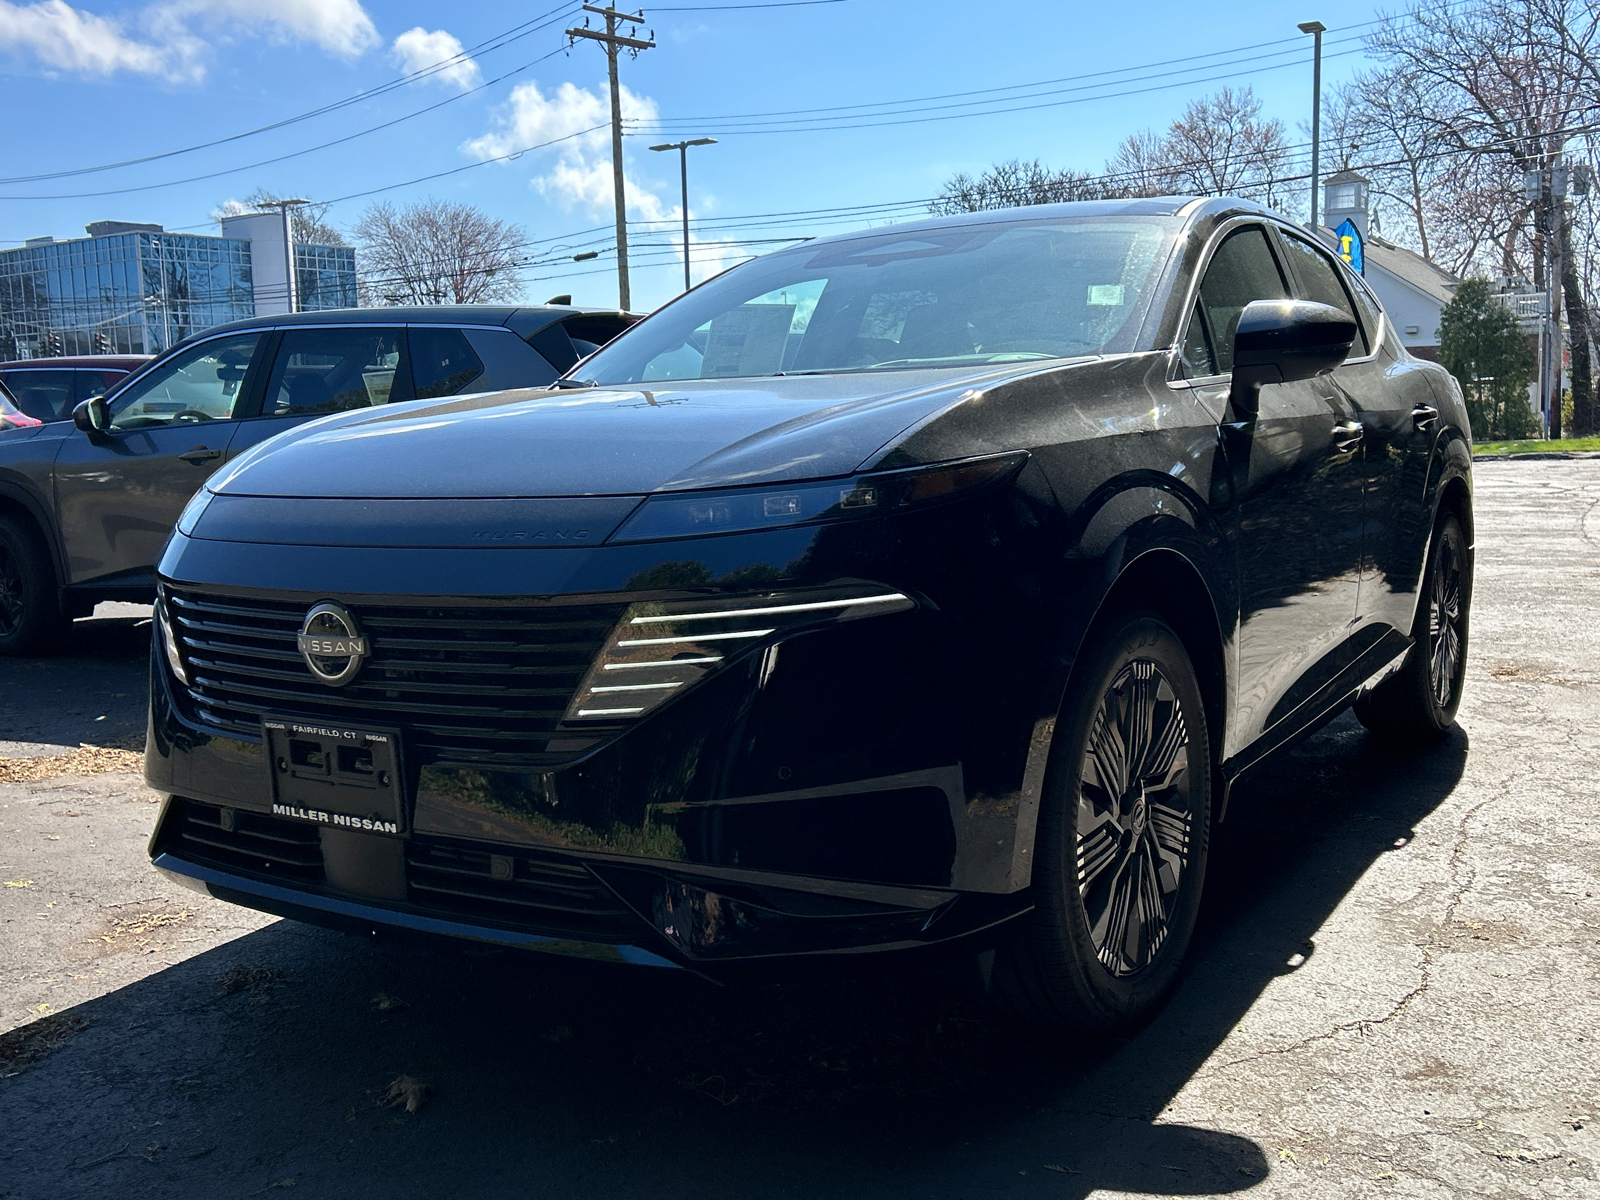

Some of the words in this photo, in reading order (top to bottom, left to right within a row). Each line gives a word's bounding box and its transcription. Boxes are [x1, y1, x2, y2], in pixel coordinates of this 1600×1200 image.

[471, 530, 591, 540] MURANO
[293, 725, 342, 738] FAIRFIELD,
[343, 731, 356, 739] CT
[273, 804, 329, 823] MILLER
[333, 814, 396, 833] NISSAN
